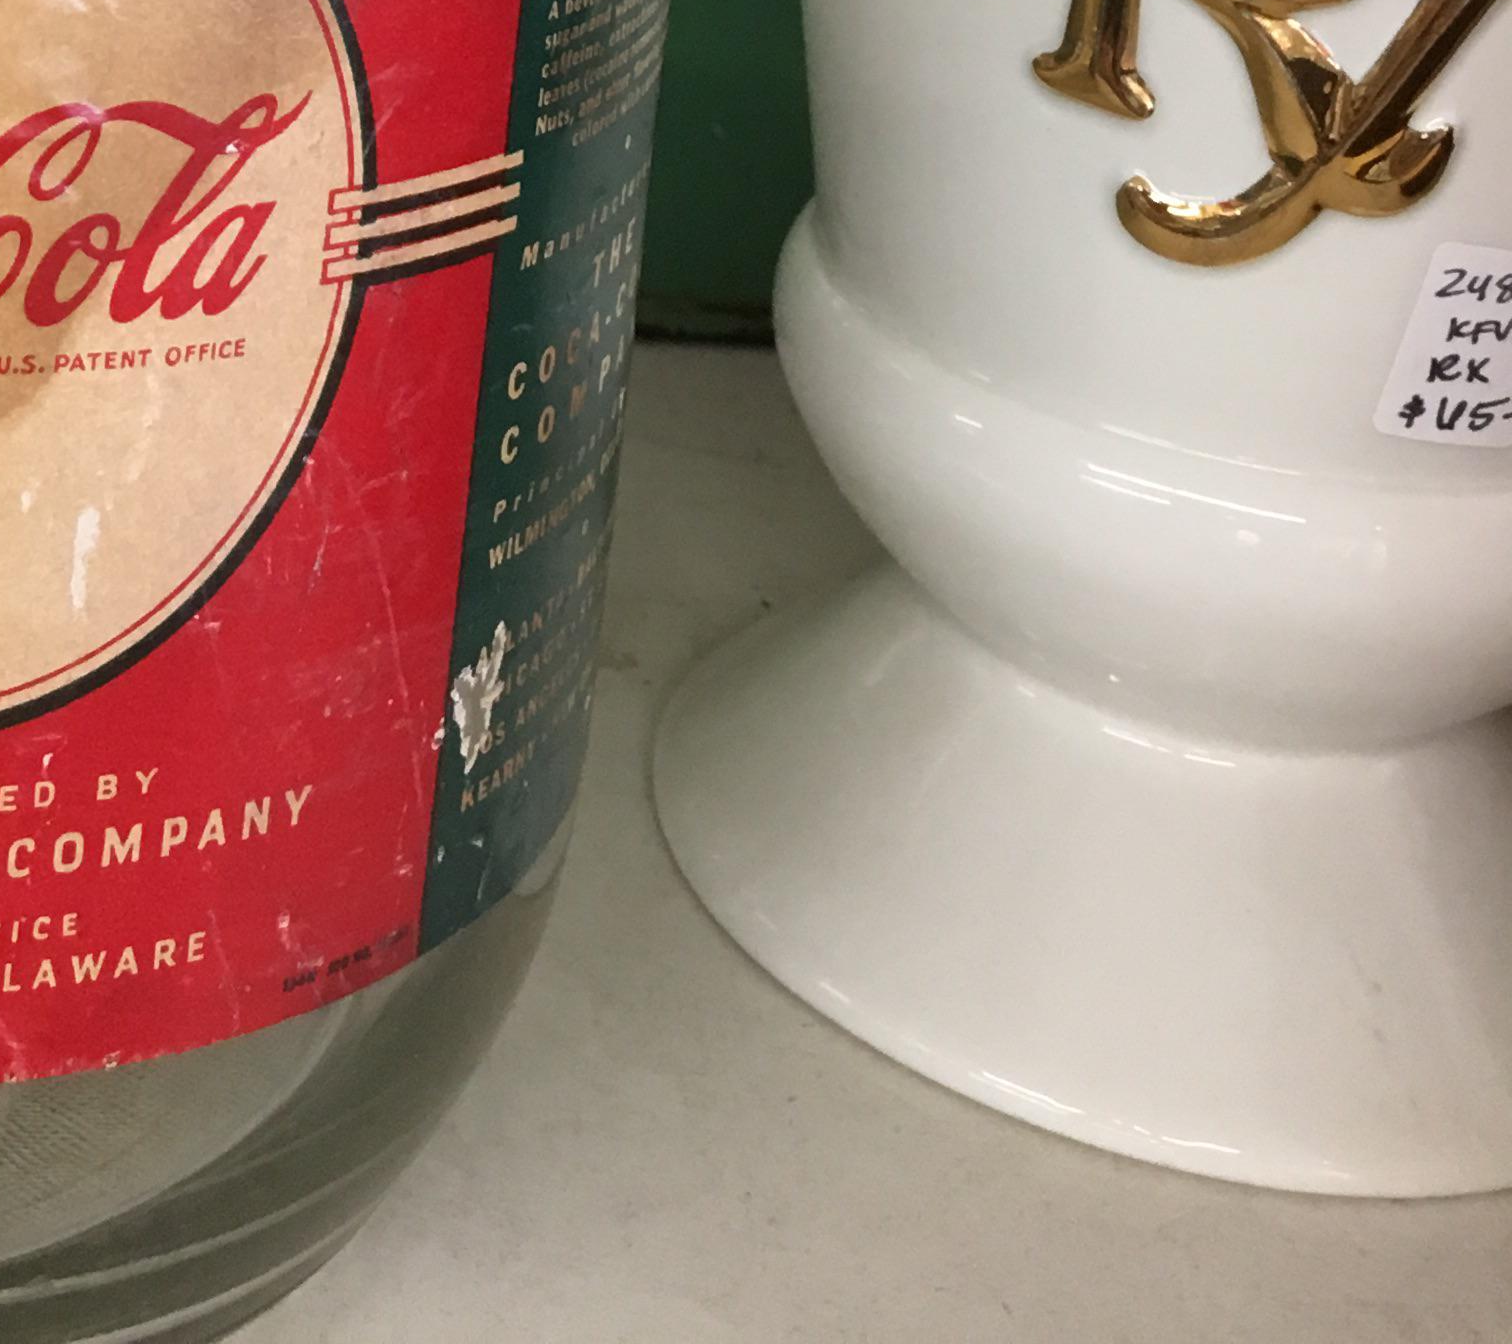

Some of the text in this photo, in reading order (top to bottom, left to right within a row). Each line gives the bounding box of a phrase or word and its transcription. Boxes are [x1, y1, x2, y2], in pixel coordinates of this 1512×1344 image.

[54, 348, 153, 374] PATENT
[164, 337, 247, 364] OFFICE
[96, 767, 160, 802] BY
[7, 785, 314, 879] COMPANY
